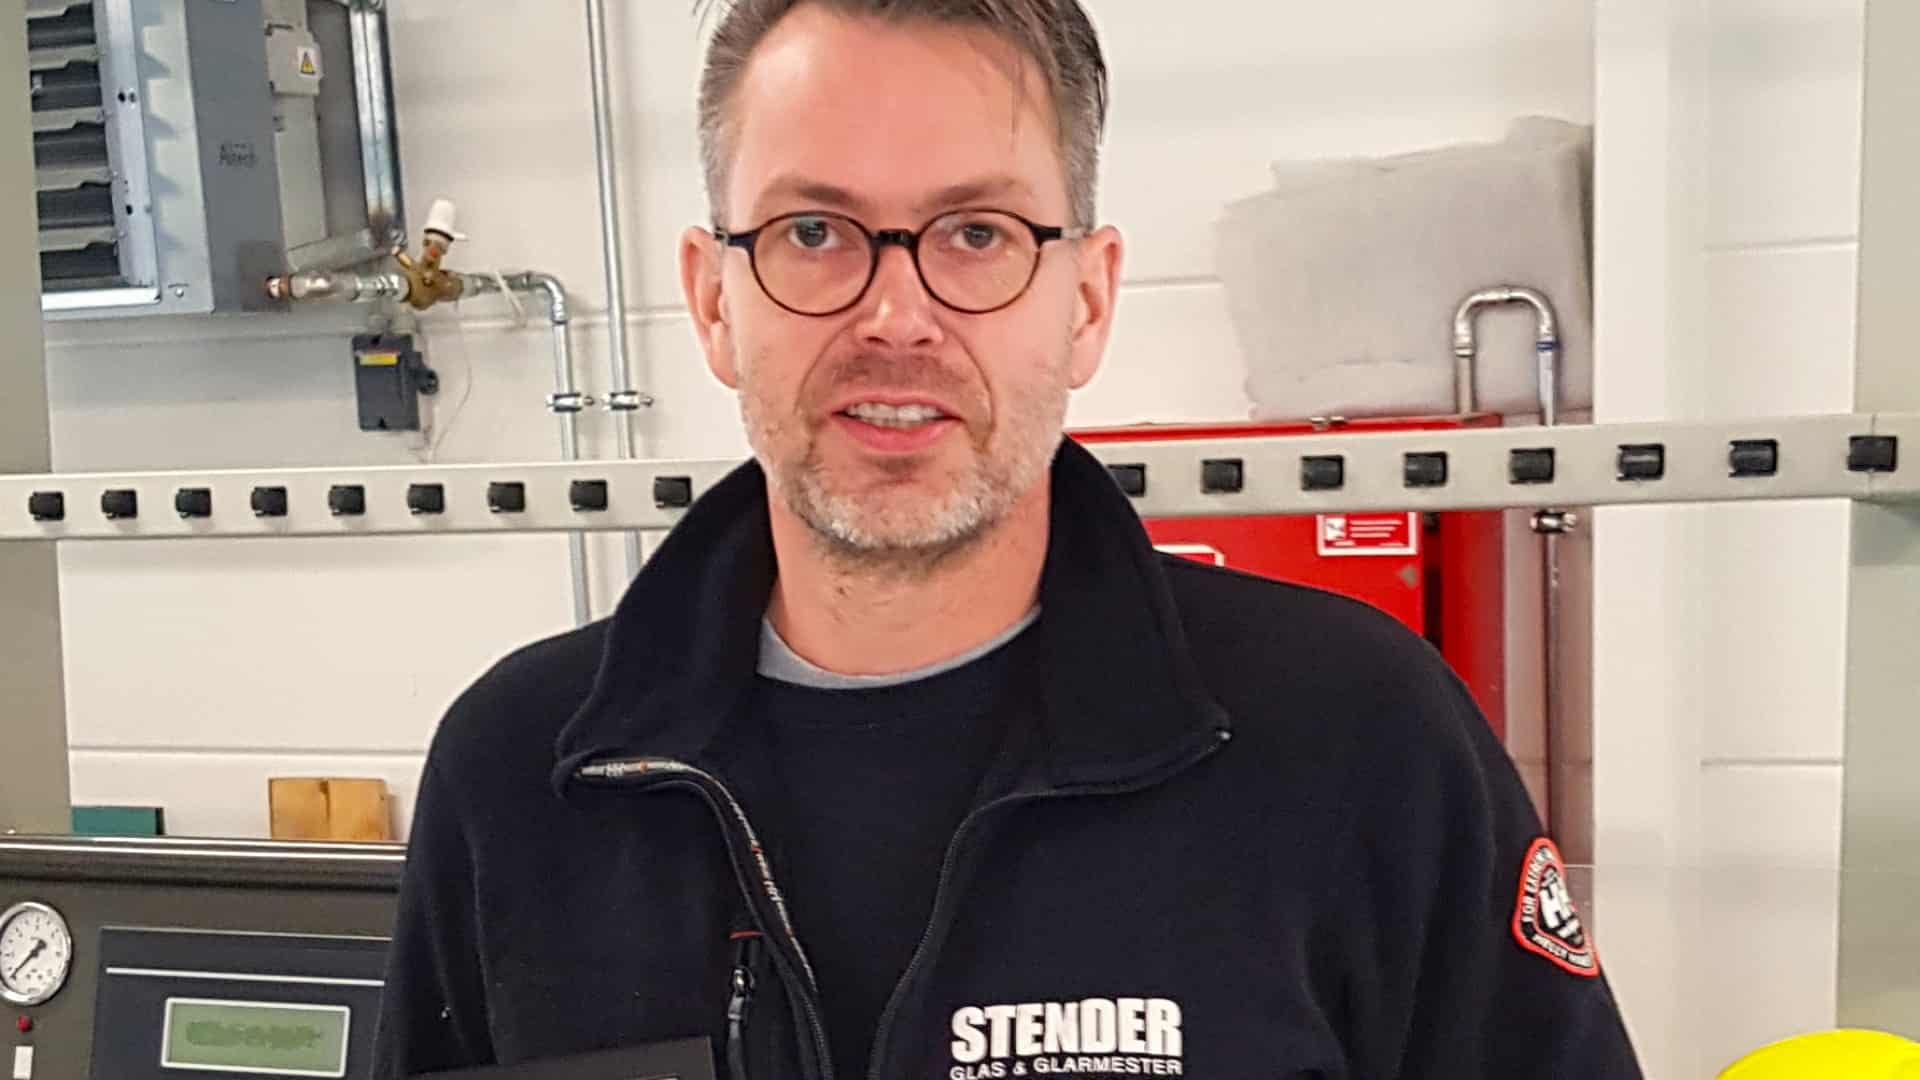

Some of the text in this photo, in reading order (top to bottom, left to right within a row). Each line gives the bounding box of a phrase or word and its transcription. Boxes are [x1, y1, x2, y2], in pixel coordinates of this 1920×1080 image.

[951, 997, 1183, 1062] STENDER
[950, 1056, 1183, 1080] GLAS & GLARMESTER
